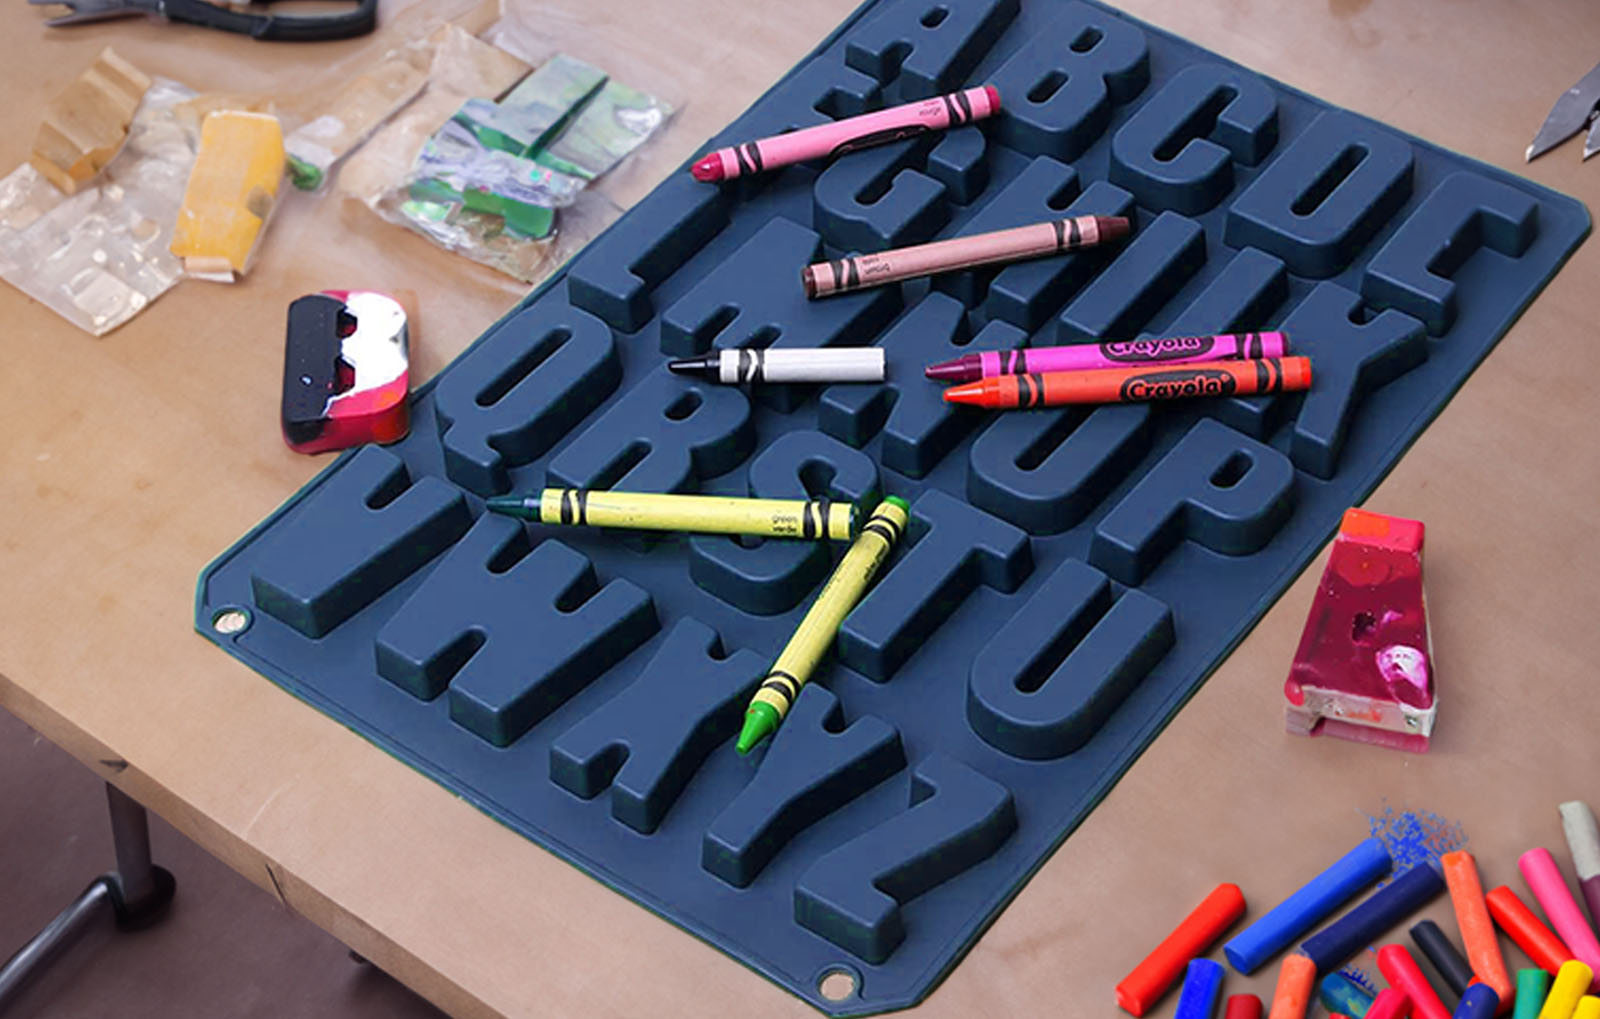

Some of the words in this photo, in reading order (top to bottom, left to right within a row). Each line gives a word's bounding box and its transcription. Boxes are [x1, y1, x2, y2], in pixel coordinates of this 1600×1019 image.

[986, 16, 1150, 148] B
[1111, 64, 1278, 200] C
[1105, 336, 1203, 358] Crayola
[1126, 373, 1223, 399] Crayola
[436, 302, 620, 485] Q
[842, 489, 1035, 668] T
[967, 558, 1175, 748] U
[1092, 417, 1295, 568] P
[550, 616, 765, 822] X
[703, 684, 905, 878] Y
[795, 755, 1018, 952] Z
